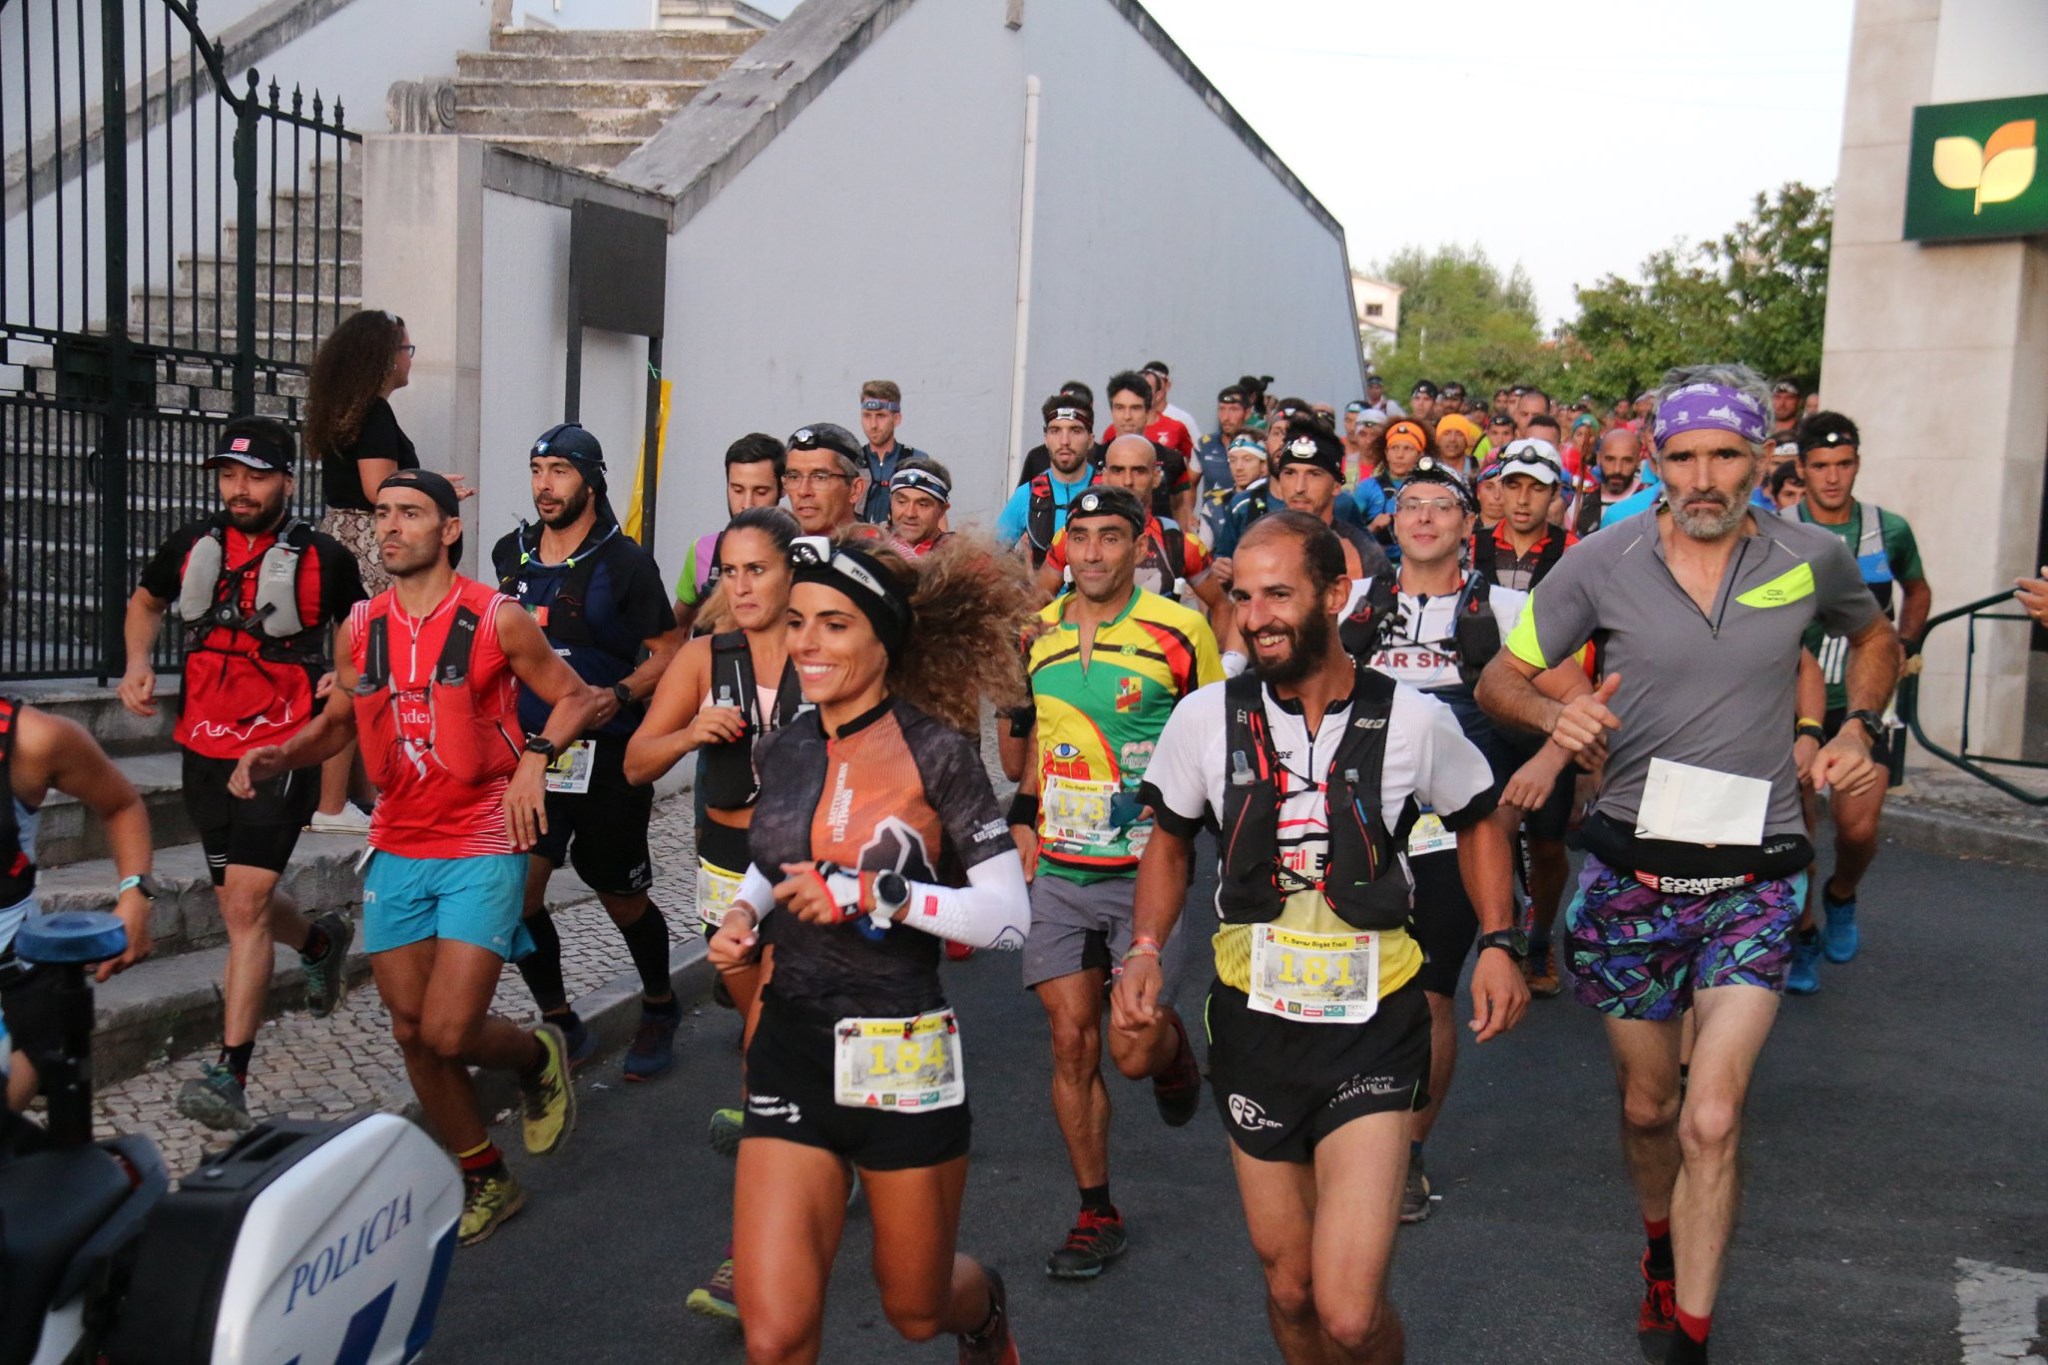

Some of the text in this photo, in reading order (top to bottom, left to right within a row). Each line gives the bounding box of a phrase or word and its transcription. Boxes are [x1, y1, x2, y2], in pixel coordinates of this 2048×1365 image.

[1058, 794, 1104, 820] 173
[1277, 952, 1354, 986] 181
[867, 1037, 945, 1077] 184
[282, 1186, 413, 1317] POLICIA
